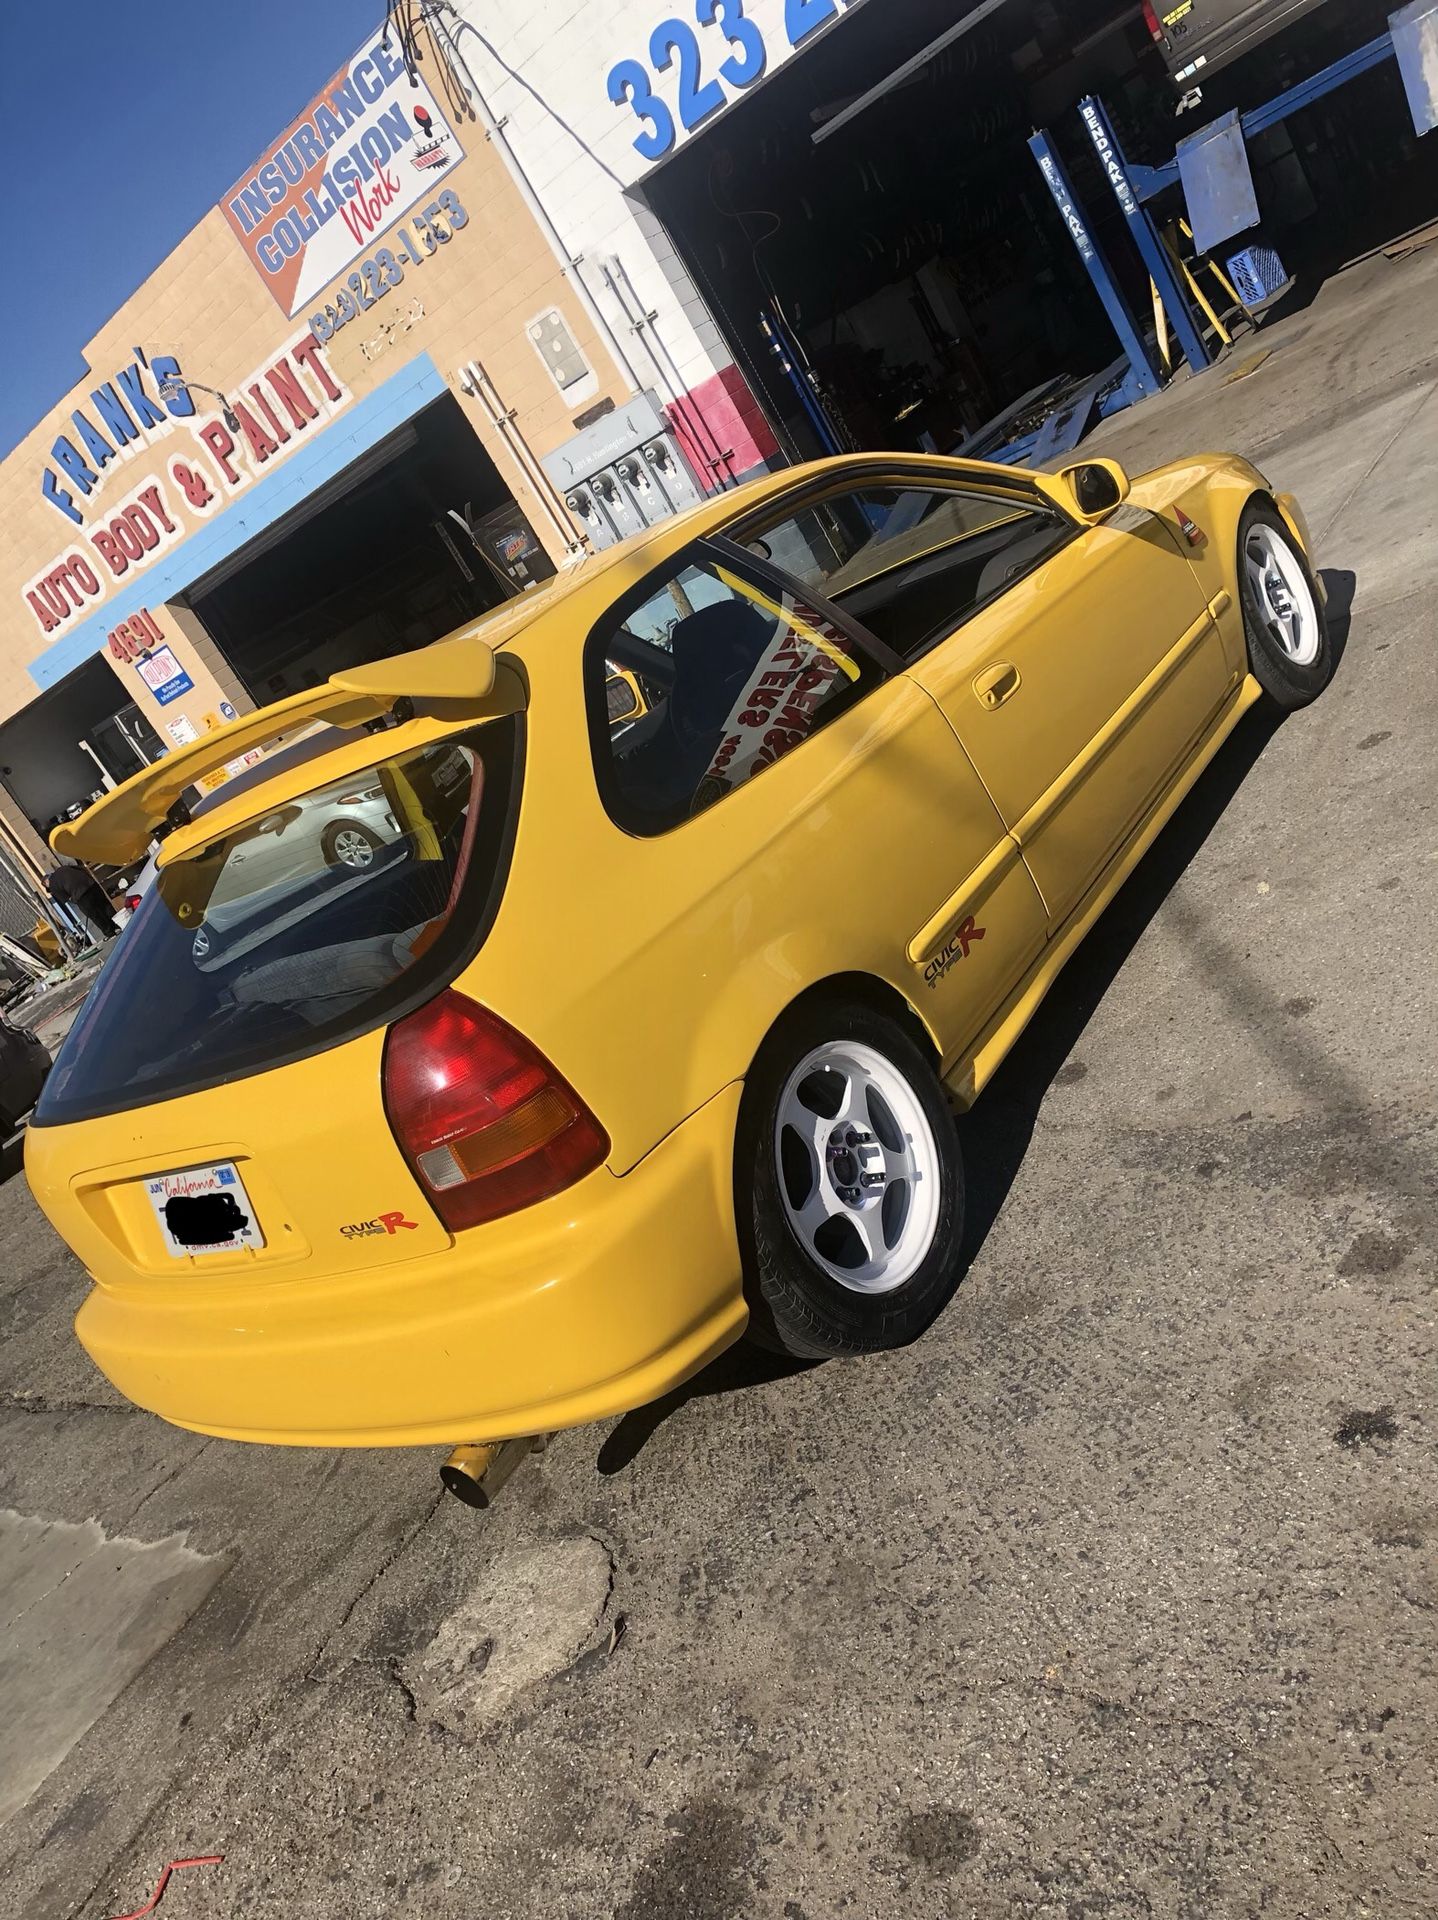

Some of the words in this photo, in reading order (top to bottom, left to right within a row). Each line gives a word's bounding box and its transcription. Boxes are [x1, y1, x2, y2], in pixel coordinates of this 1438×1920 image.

[229, 38, 405, 236] INSURANCE
[255, 100, 414, 274] COLLISION
[338, 157, 401, 246] Work
[41, 346, 197, 525] FRANK'S
[26, 553, 101, 632] AUTO
[91, 485, 176, 577] BODY
[173, 463, 214, 508] &
[199, 333, 342, 485] PAINT
[108, 607, 165, 664] 4691
[924, 937, 959, 981] CIVIC
[955, 915, 987, 958] R
[149, 1183, 163, 1194] JUN
[163, 1174, 223, 1198] California
[339, 1218, 383, 1235] CIVIC
[344, 1226, 387, 1241] TYPE
[378, 1211, 419, 1235] R
